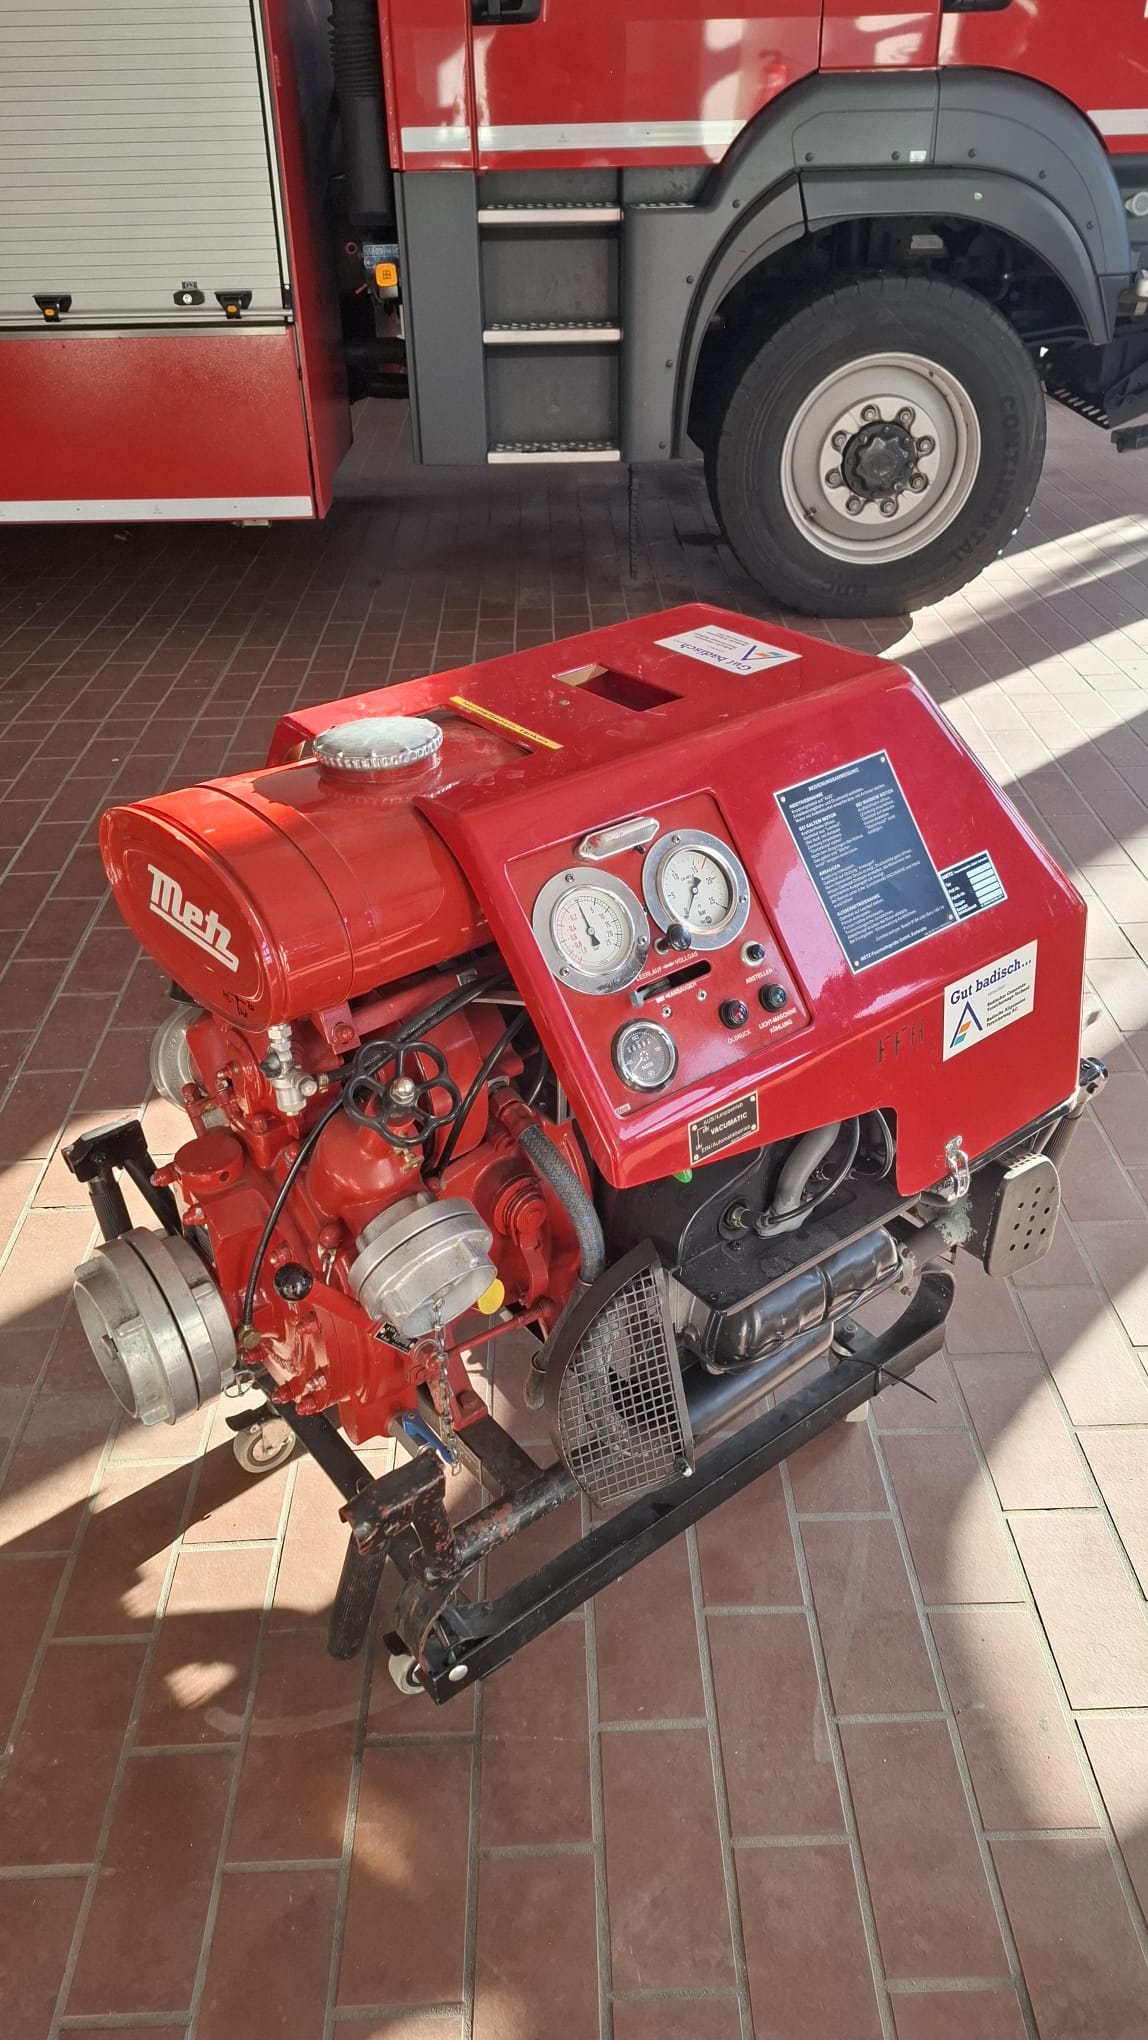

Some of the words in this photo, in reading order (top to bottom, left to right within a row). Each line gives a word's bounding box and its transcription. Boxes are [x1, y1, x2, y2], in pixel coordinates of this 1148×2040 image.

[954, 396, 1021, 562] CONTINENTAL
[726, 658, 752, 671] Gut
[674, 950, 699, 965] VOLLGAS
[951, 985, 972, 1004] Gut
[976, 959, 1031, 992] badisch...
[710, 1112, 748, 1135] VACUMATIC
